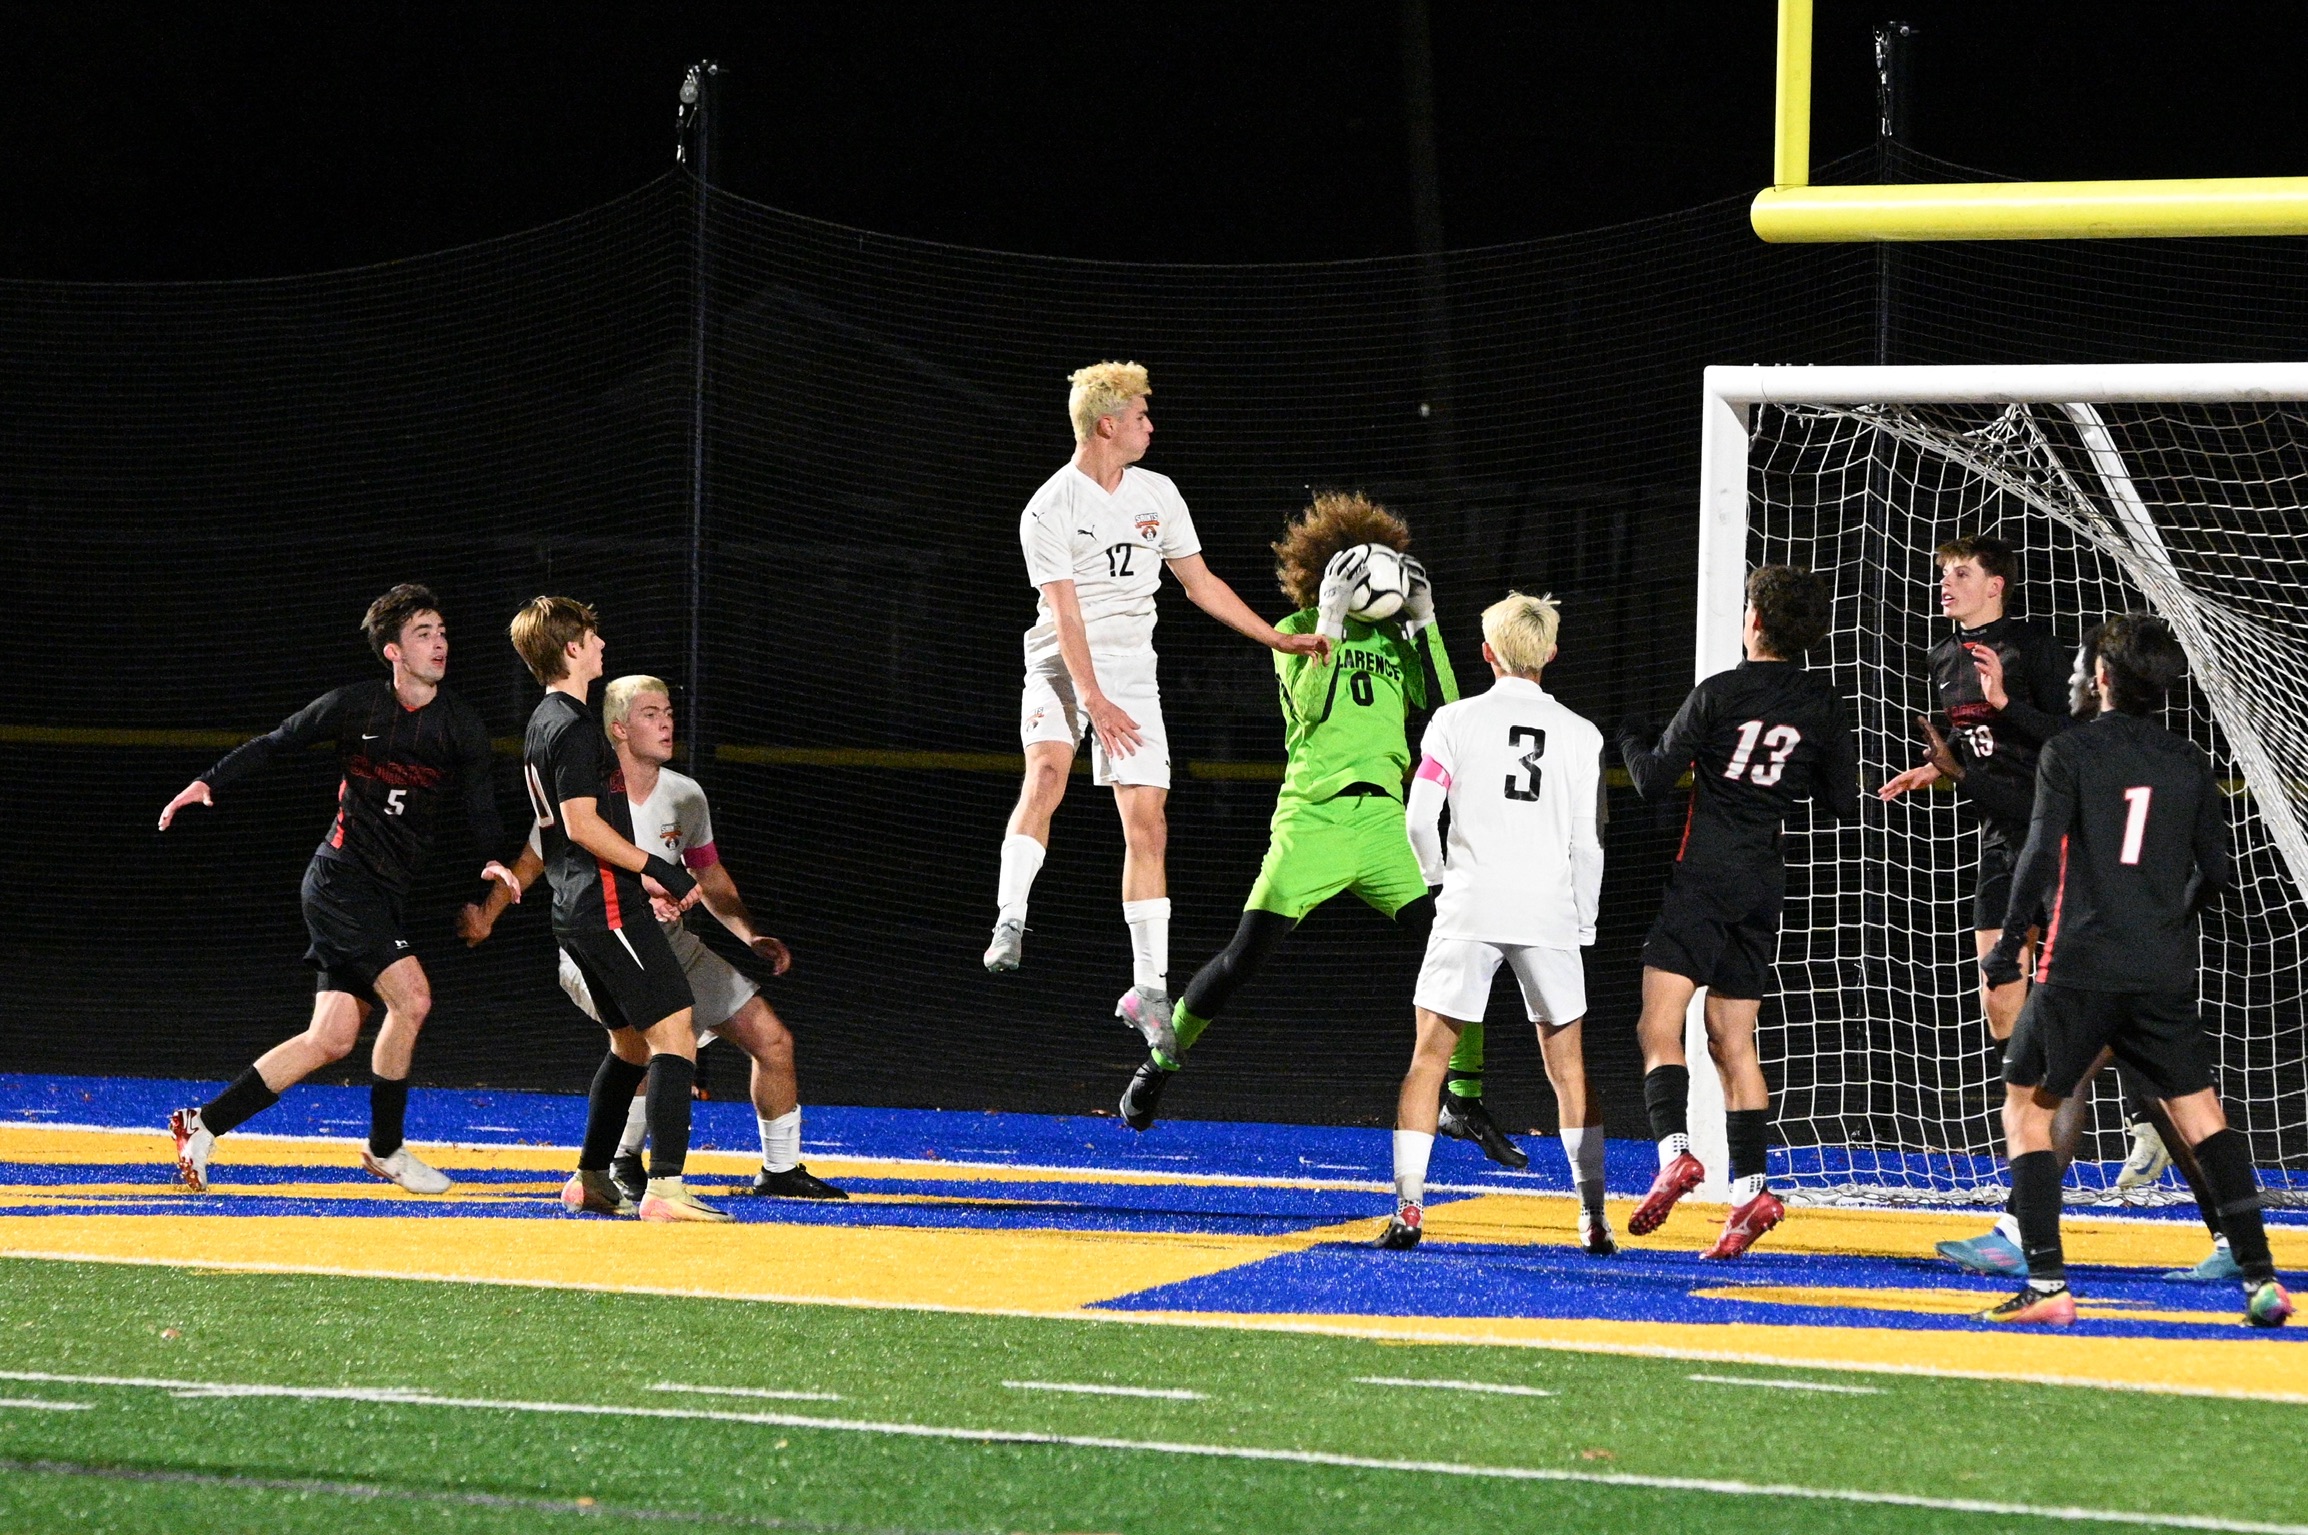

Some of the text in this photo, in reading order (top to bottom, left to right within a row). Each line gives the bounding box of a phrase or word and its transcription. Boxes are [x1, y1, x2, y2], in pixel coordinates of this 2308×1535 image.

[1106, 543, 1134, 577] 12
[1350, 671, 1375, 706] 0
[1504, 725, 1546, 802] 3
[1723, 720, 1801, 787] 13
[384, 789, 408, 816] 5
[2119, 785, 2152, 866] 1
